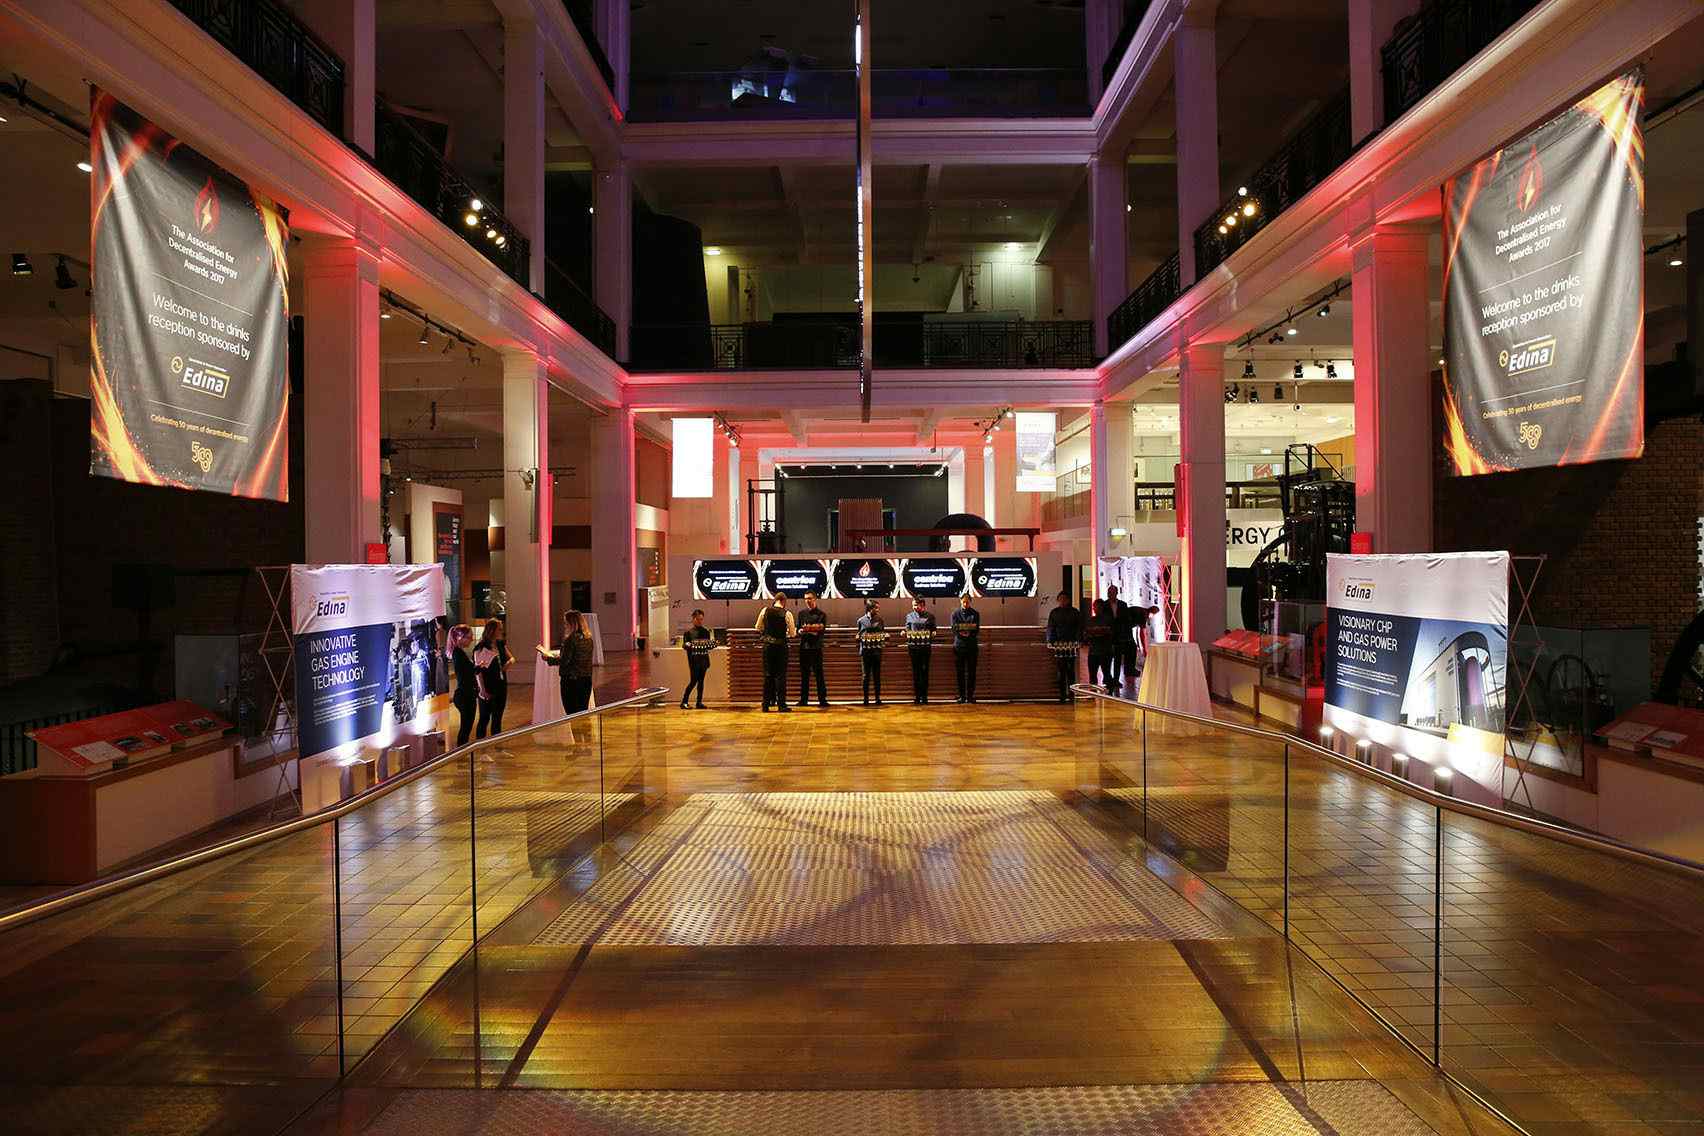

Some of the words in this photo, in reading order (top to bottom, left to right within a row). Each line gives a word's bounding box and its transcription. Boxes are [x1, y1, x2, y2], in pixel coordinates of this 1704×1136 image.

[1497, 230, 1509, 240] The
[1510, 210, 1550, 235] Association
[1550, 204, 1562, 216] for
[172, 224, 186, 240] The
[186, 233, 224, 259] Association
[226, 252, 234, 264] for
[1496, 227, 1538, 255] Decentralised
[1540, 218, 1568, 235] Energy
[168, 237, 214, 267] Decentralised
[215, 260, 238, 280] Energy
[1508, 244, 1534, 263] Awards
[1534, 236, 1551, 252] 2017
[184, 259, 208, 278] Awards
[210, 271, 225, 284] 2017
[1482, 298, 1520, 319] Welcome
[1522, 293, 1532, 305] to
[1534, 287, 1550, 300] the
[1552, 274, 1580, 294] drinks
[152, 292, 198, 322] Welcome
[199, 312, 209, 326] to
[210, 316, 225, 332] the
[226, 323, 250, 342] drinks
[1482, 316, 1518, 336] reception
[1520, 296, 1567, 325] sponsored
[1569, 294, 1584, 308] by
[148, 313, 196, 339] reception
[196, 331, 240, 355] sponsored
[241, 344, 250, 360] by
[1508, 347, 1550, 372] Edina
[182, 366, 224, 392] Edina
[712, 581, 746, 591] Edina
[987, 578, 1022, 588] Edina
[1345, 584, 1371, 599] Edina
[316, 600, 346, 617] Edina
[1338, 614, 1376, 630] VISIONARY
[1376, 618, 1392, 634] CHP
[310, 634, 357, 654] INNOVATIVE
[1338, 631, 1353, 644] AND
[1354, 632, 1370, 647] GAS
[1370, 635, 1398, 652] POWER
[311, 656, 330, 672] GAS
[330, 650, 359, 668] ENGINE
[1338, 645, 1377, 664] SOLUTIONS
[312, 666, 366, 691] TECHNOLOGY
